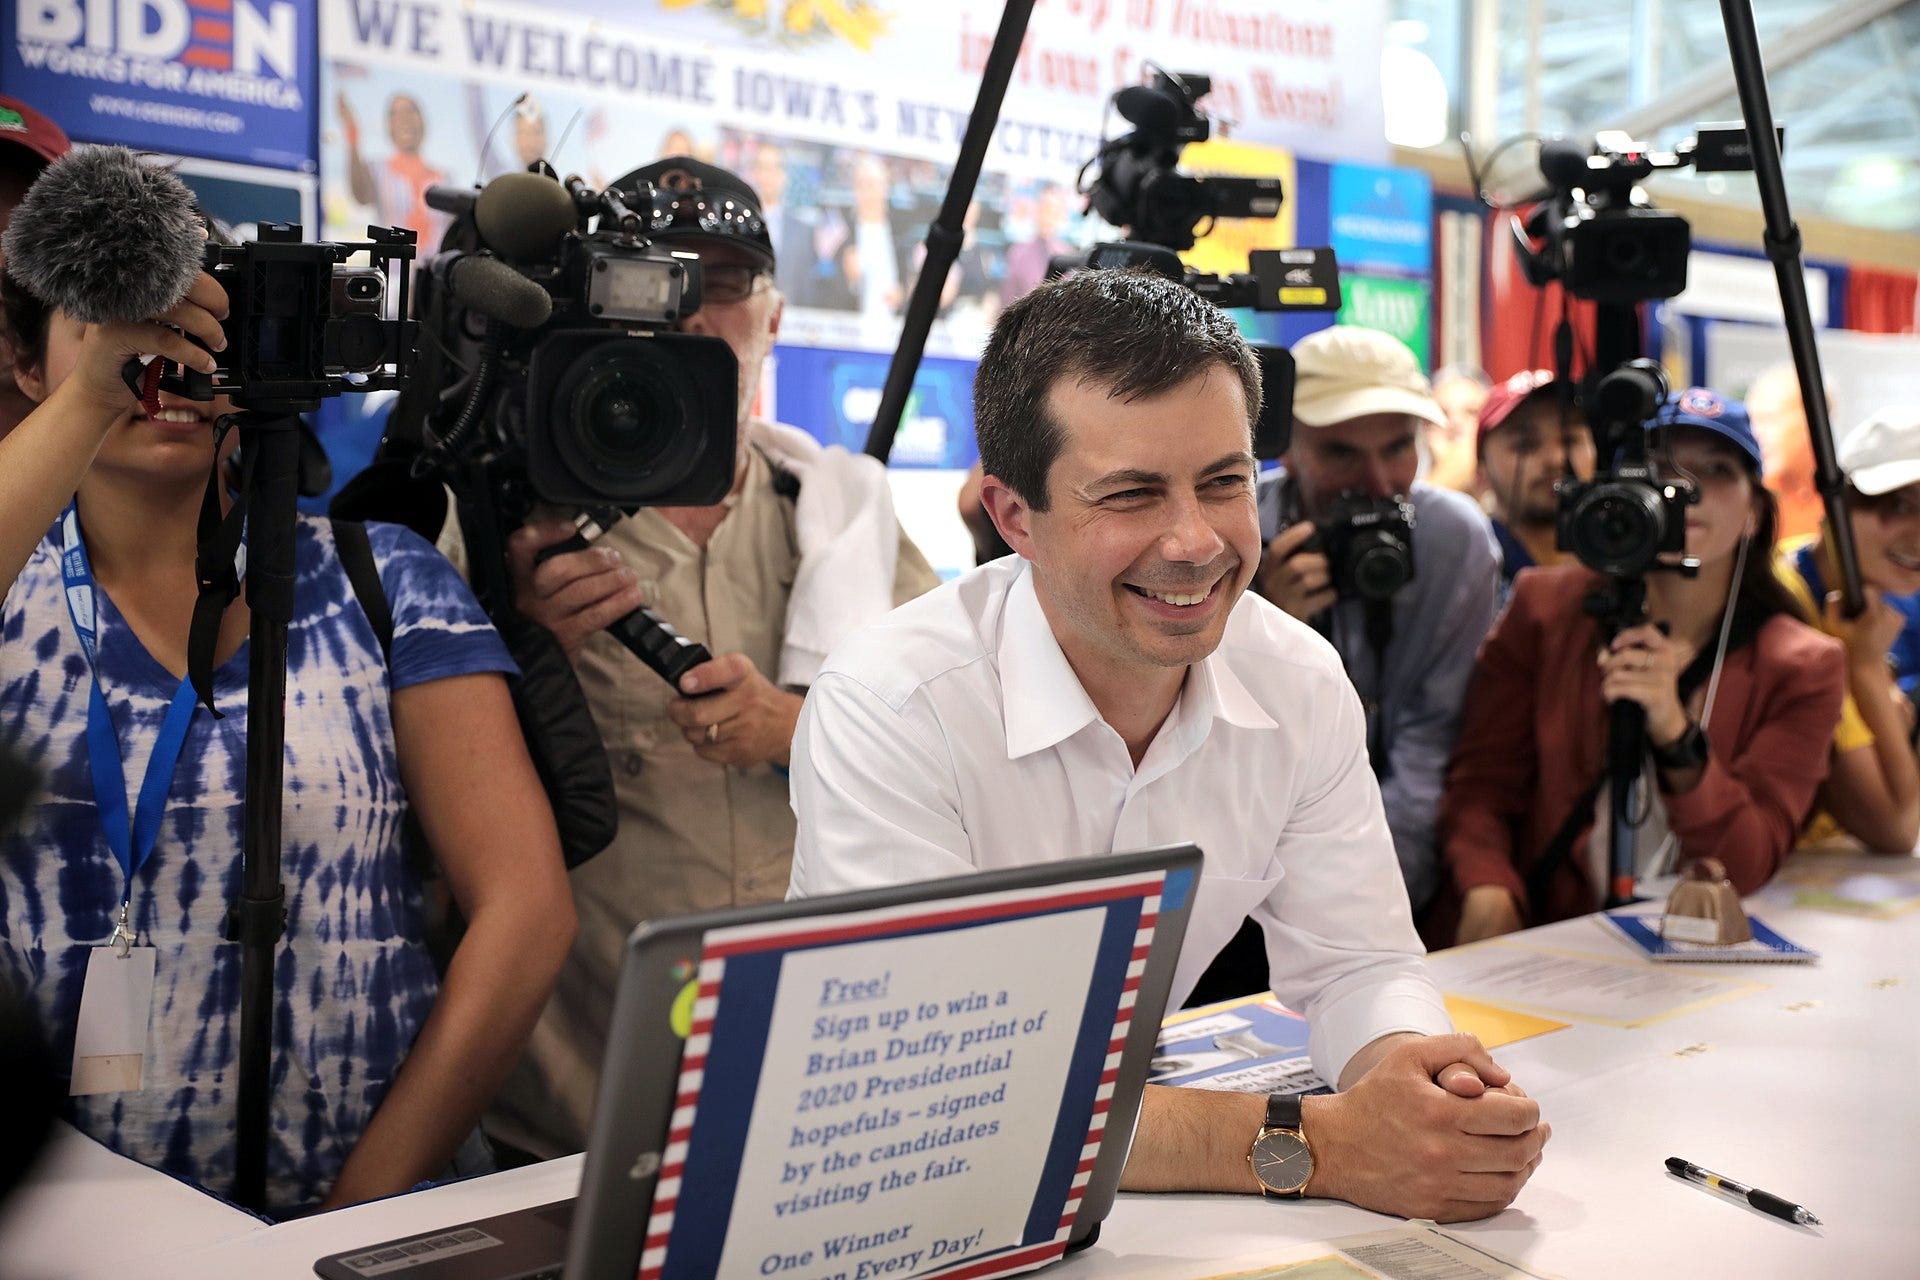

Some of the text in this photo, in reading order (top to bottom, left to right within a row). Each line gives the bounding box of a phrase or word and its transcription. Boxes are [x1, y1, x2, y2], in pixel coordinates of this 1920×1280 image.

[15, 0, 298, 80] BIDEN
[350, 0, 442, 57] WE
[462, 12, 716, 107] WELCOME
[734, 66, 880, 133] IOWA'S
[17, 43, 302, 111] WORKS FOR AMERICA
[812, 989, 1009, 1041] Sign up to win a
[821, 971, 891, 1005] Free!
[804, 1010, 1048, 1076] Brian Duffy print of
[796, 1049, 1013, 1113] 2020 Presidential
[789, 1107, 903, 1149] hopefuls
[926, 1083, 1007, 1119] signed
[780, 1119, 1000, 1184] by the candidates
[773, 1157, 973, 1218] visiting the fair.
[760, 1223, 914, 1277] One Winner
[853, 1227, 985, 1280] Every Day!
